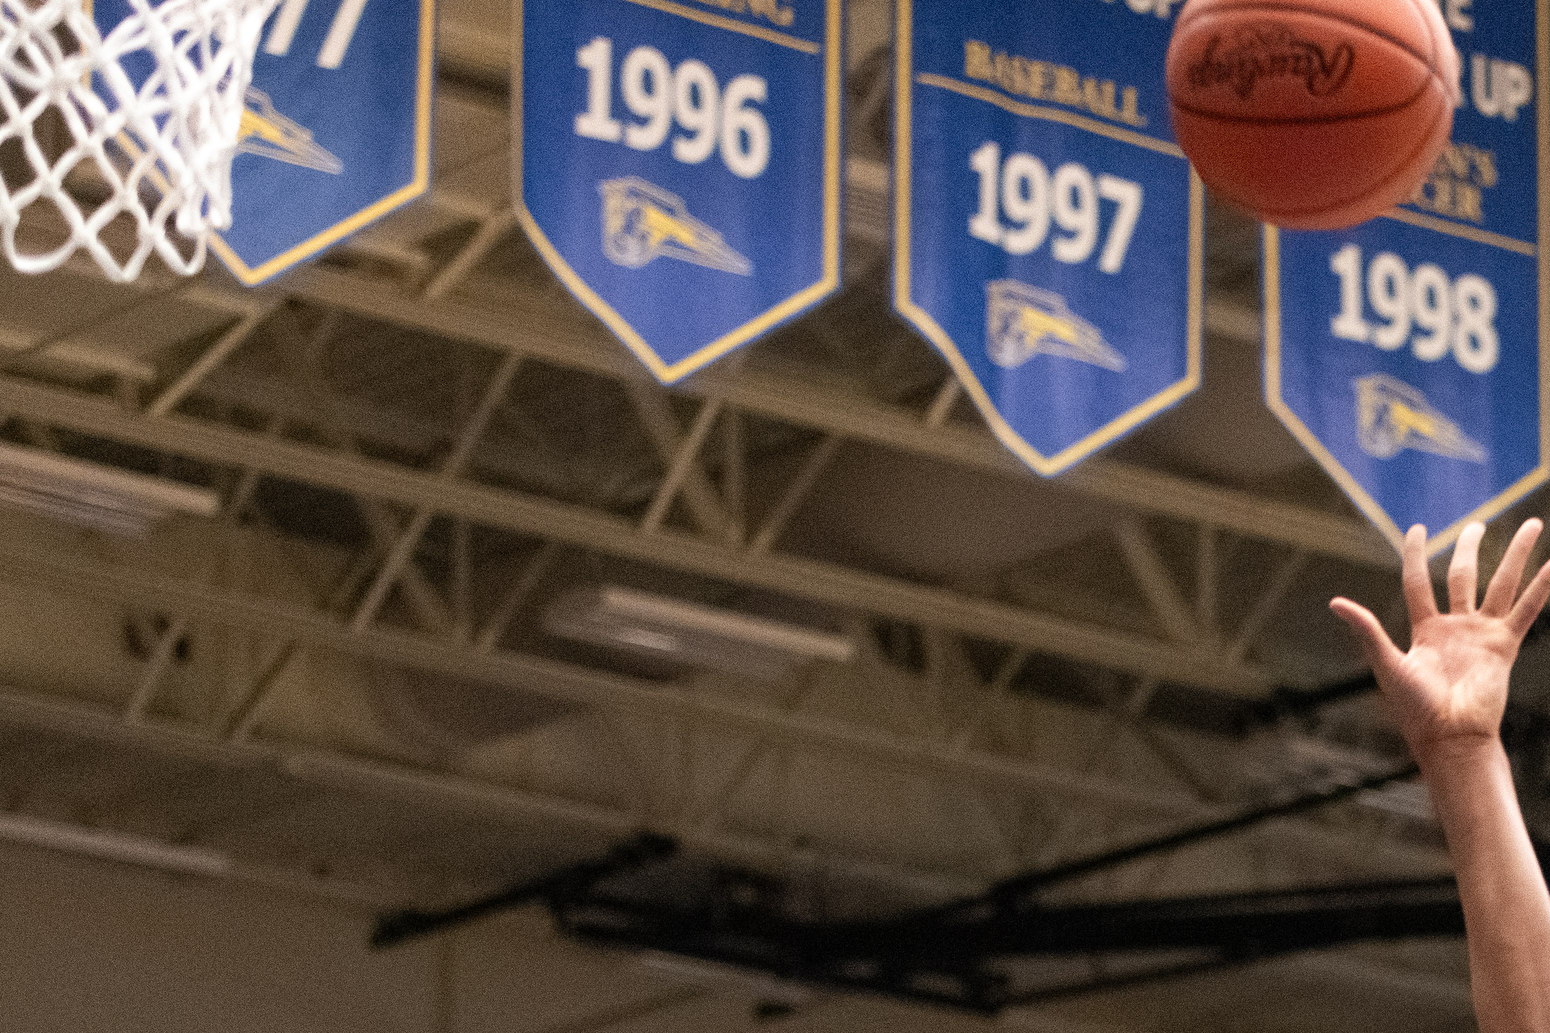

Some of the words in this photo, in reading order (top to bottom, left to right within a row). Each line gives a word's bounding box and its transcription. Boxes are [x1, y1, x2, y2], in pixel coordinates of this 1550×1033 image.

[574, 37, 770, 178] 1996
[964, 40, 1147, 127] BASEBALL
[1471, 53, 1533, 122] UP
[969, 141, 1144, 273] 1997
[1330, 244, 1498, 374] 1998
